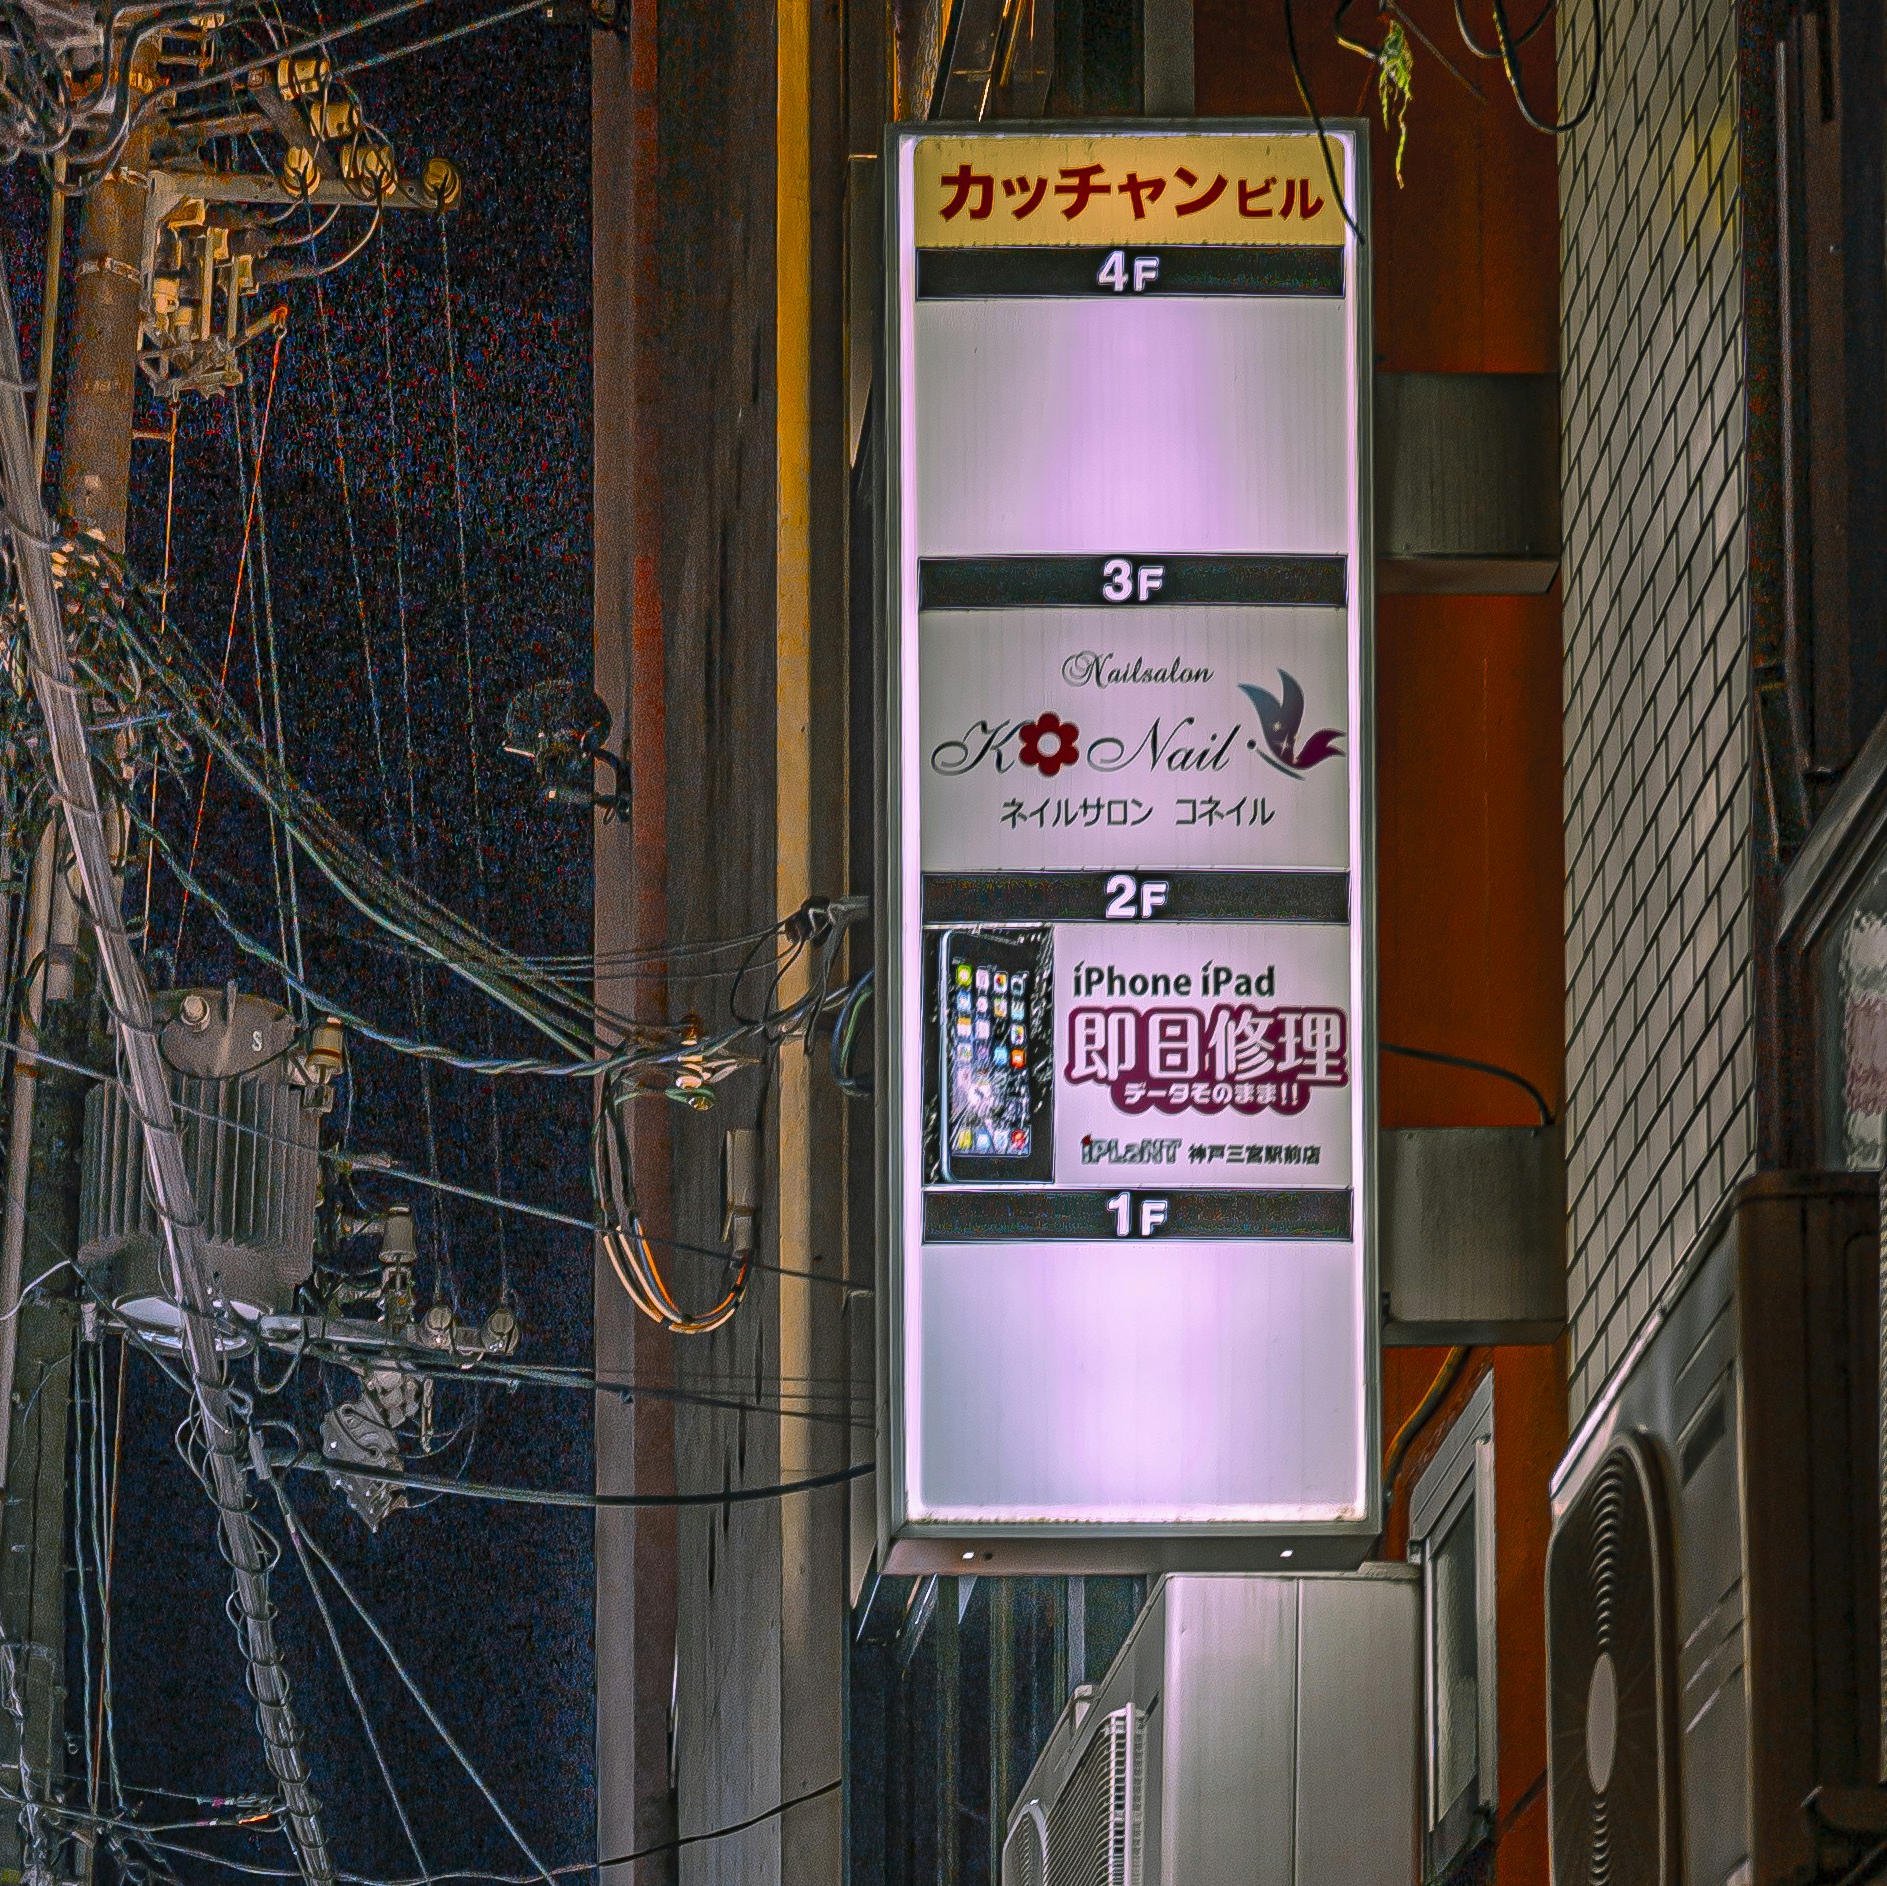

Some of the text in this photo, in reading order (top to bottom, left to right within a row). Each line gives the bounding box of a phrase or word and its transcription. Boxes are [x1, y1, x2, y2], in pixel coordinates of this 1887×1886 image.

[939, 163, 1325, 222] カッチャンビル
[1097, 252, 1160, 293] 4F
[1102, 558, 1164, 602] 3F
[1061, 649, 1214, 690] Nailsalon
[1086, 715, 1242, 776] Nail
[1000, 796, 1277, 830] ネイルサロン コネイル
[1105, 874, 1169, 919] 2F
[1072, 958, 1276, 998] iPhone iPad
[1069, 1007, 1344, 1085] 即日修理
[1107, 1192, 1169, 1237] 1F
